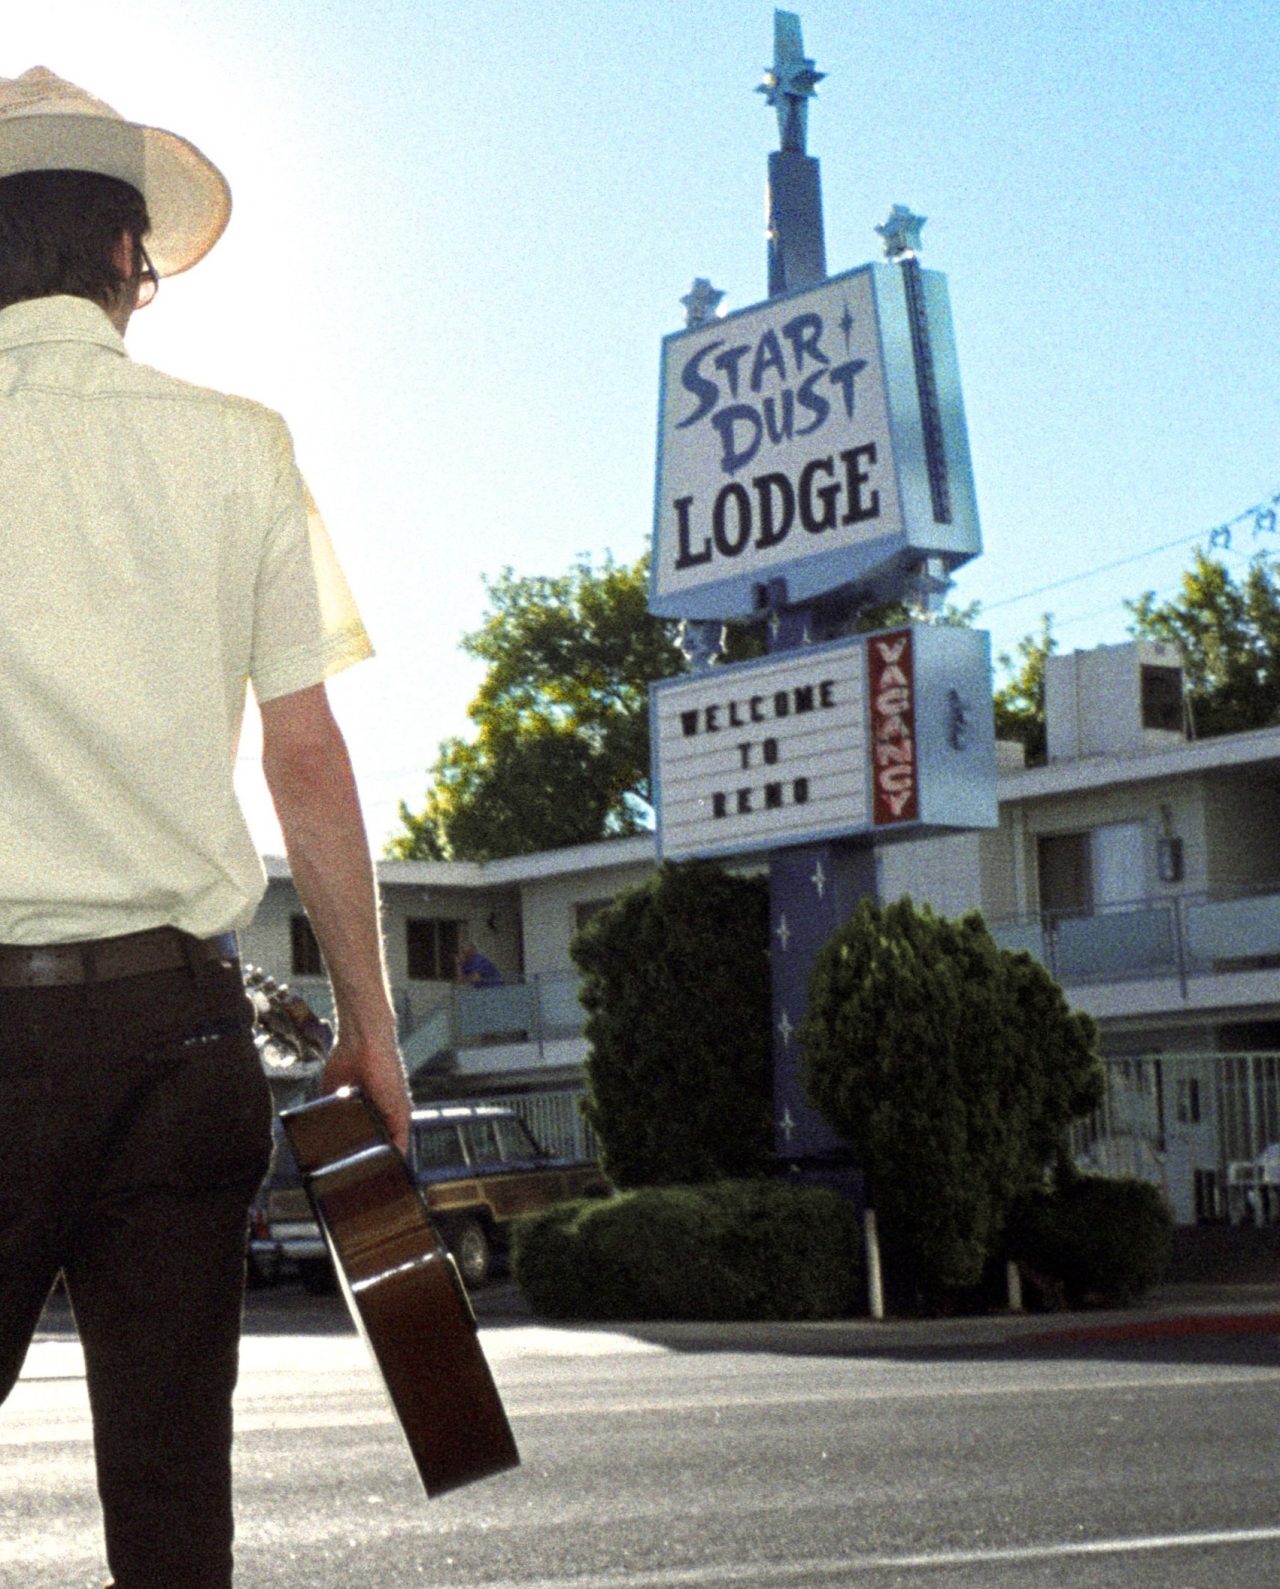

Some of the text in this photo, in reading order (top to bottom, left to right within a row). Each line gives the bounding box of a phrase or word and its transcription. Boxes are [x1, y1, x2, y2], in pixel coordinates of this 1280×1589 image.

[675, 312, 829, 430] STAR
[711, 359, 868, 476] DUST
[673, 442, 880, 570] LODGE
[680, 680, 836, 737] WELCOME
[738, 738, 778, 770] TO
[874, 637, 914, 817] VACANCY
[712, 777, 809, 819] RENO
